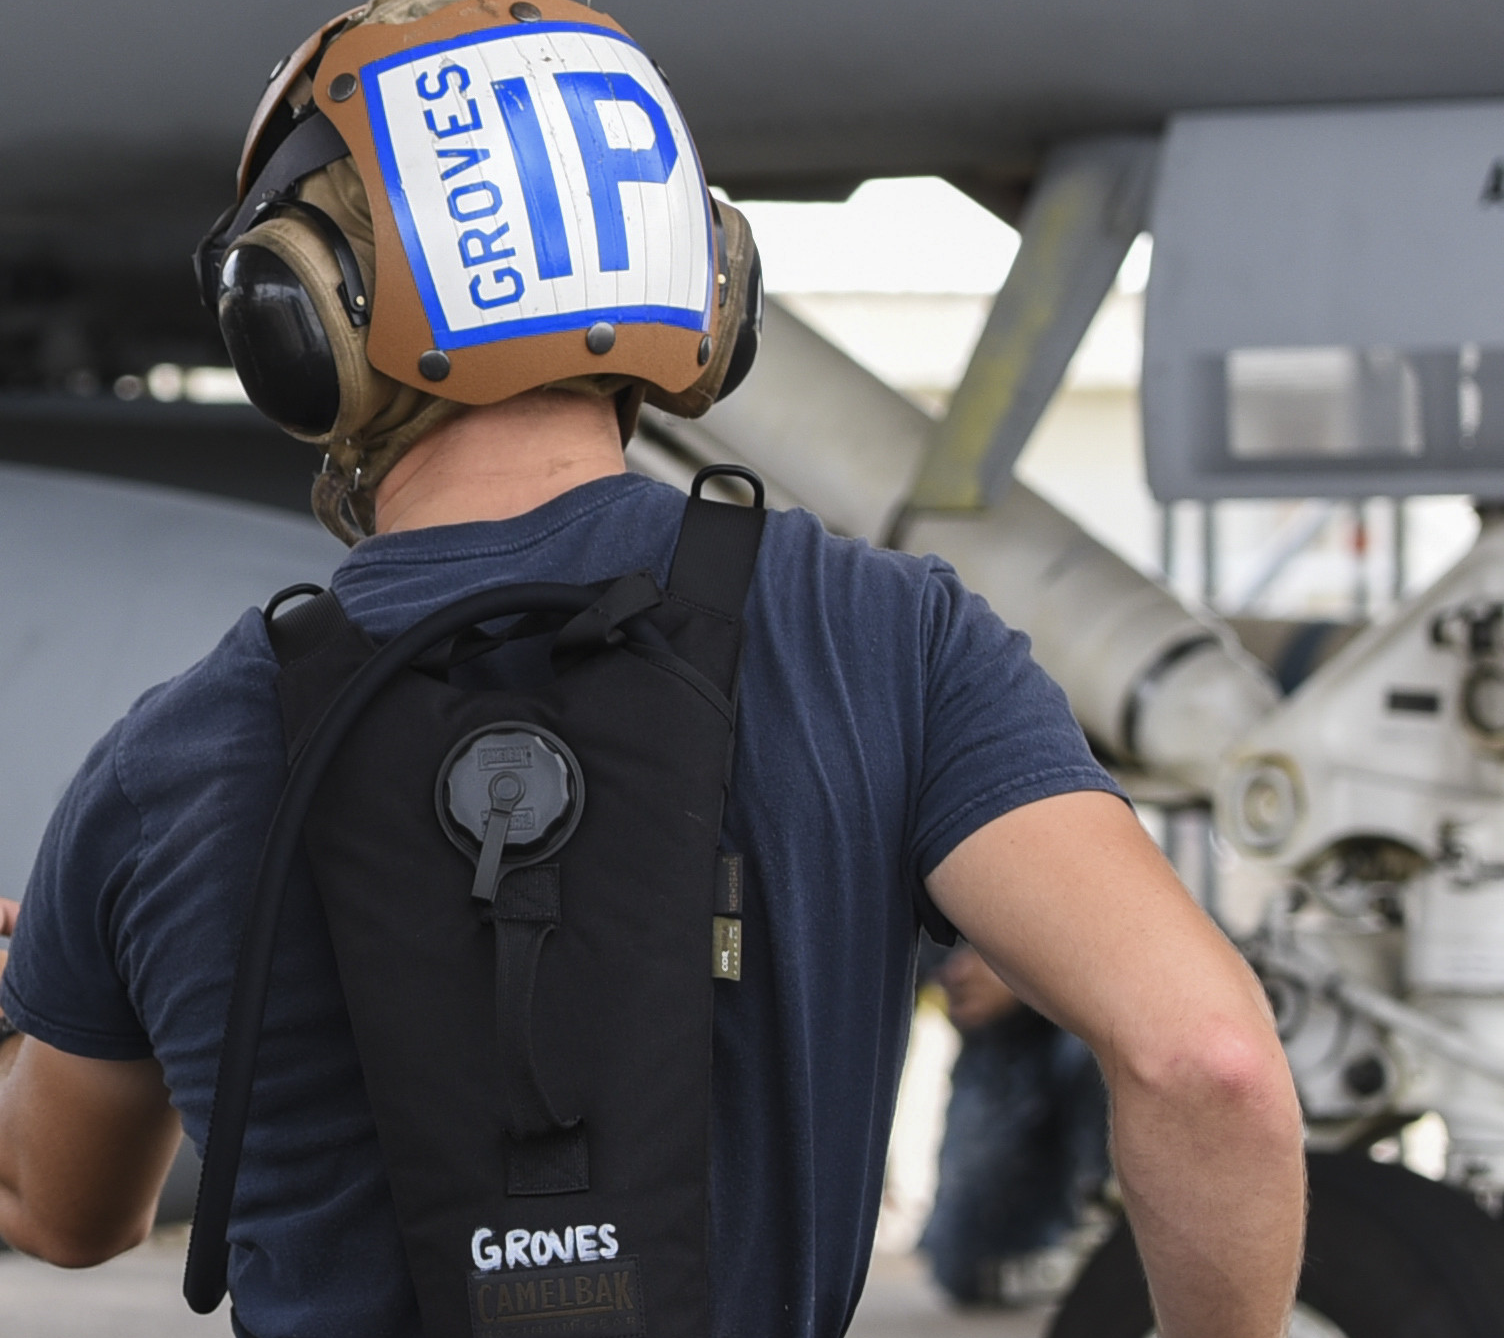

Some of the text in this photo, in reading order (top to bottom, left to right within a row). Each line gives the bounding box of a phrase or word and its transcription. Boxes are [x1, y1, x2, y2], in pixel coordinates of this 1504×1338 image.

[415, 62, 526, 311] GROVES
[490, 71, 679, 282] IP
[470, 1222, 620, 1272] GROVES
[476, 1270, 635, 1324] CAMELBAK
